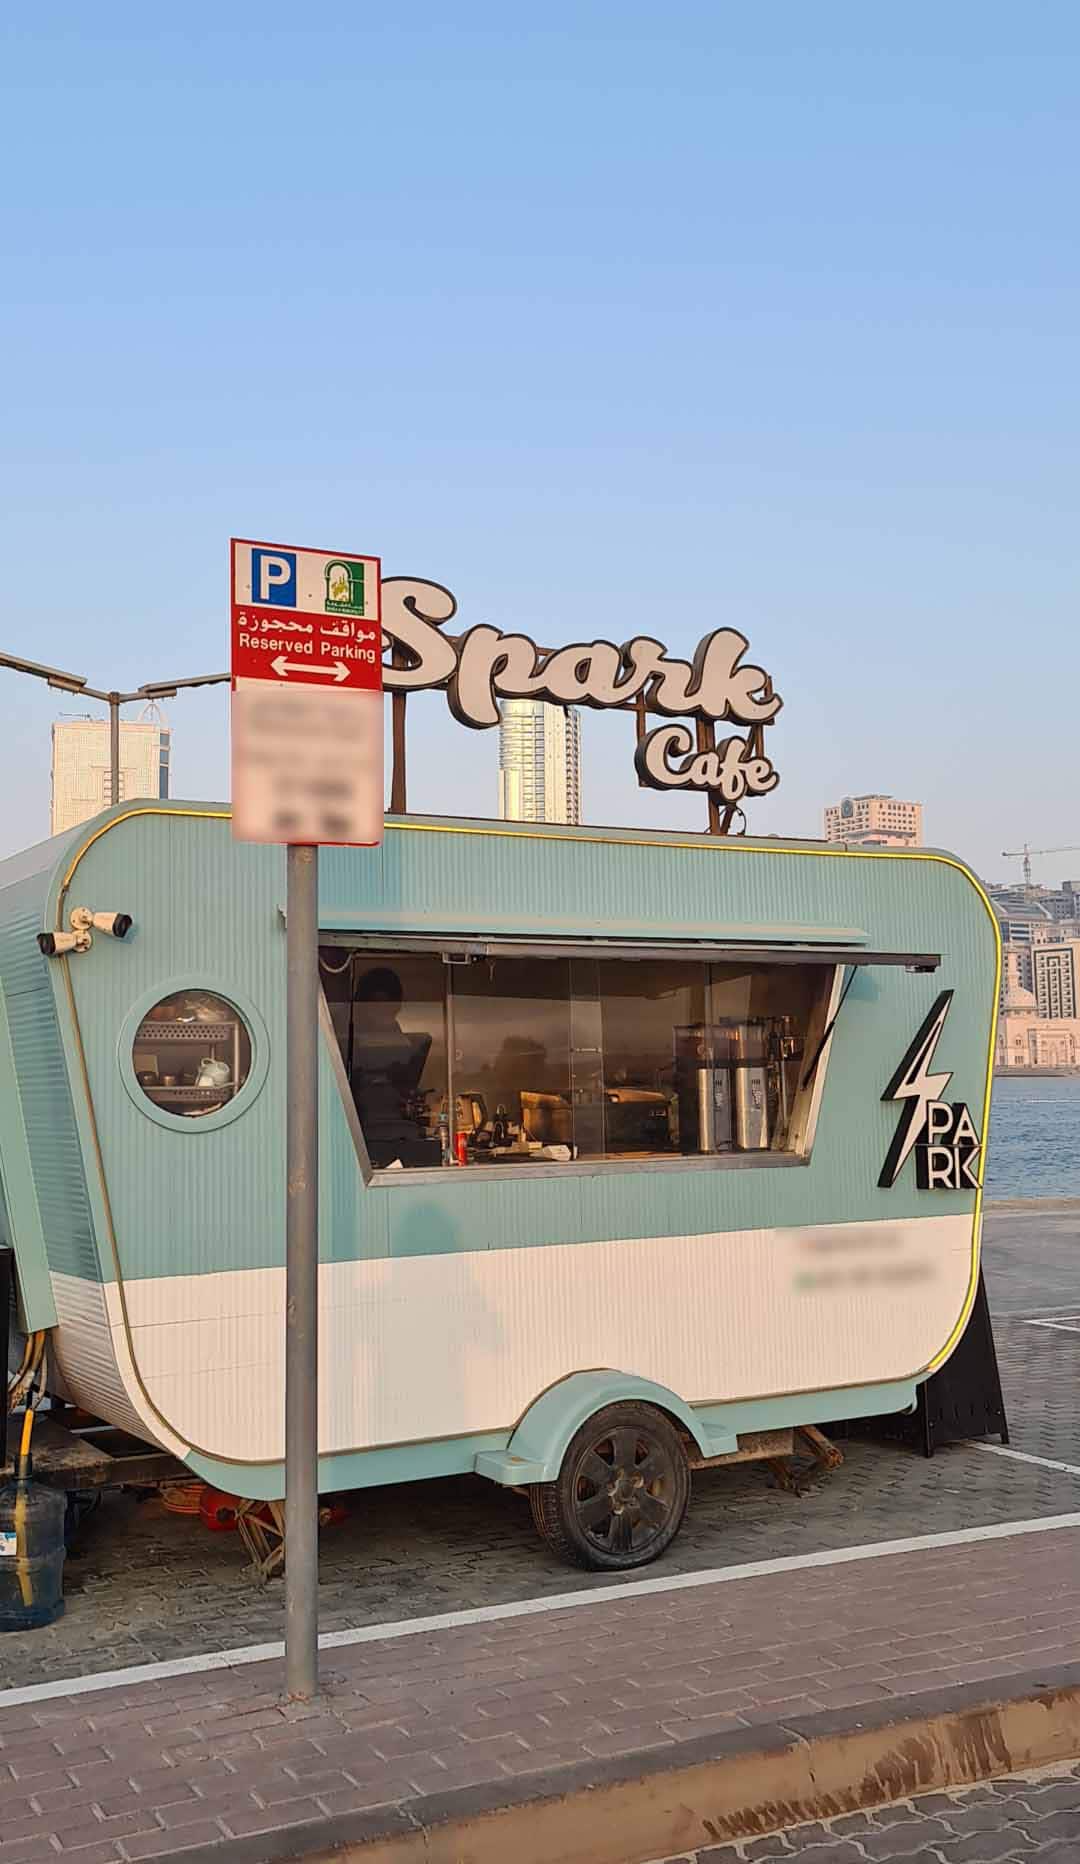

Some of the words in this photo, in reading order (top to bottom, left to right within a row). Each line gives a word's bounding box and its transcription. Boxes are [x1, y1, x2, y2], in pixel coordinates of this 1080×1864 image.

[260, 555, 291, 600] P
[238, 611, 313, 632] محجوزة
[319, 620, 376, 642] مواقف
[239, 633, 313, 654] Reserved
[320, 641, 376, 664] Parking
[381, 576, 783, 728] Spark
[638, 724, 781, 803] Cafe
